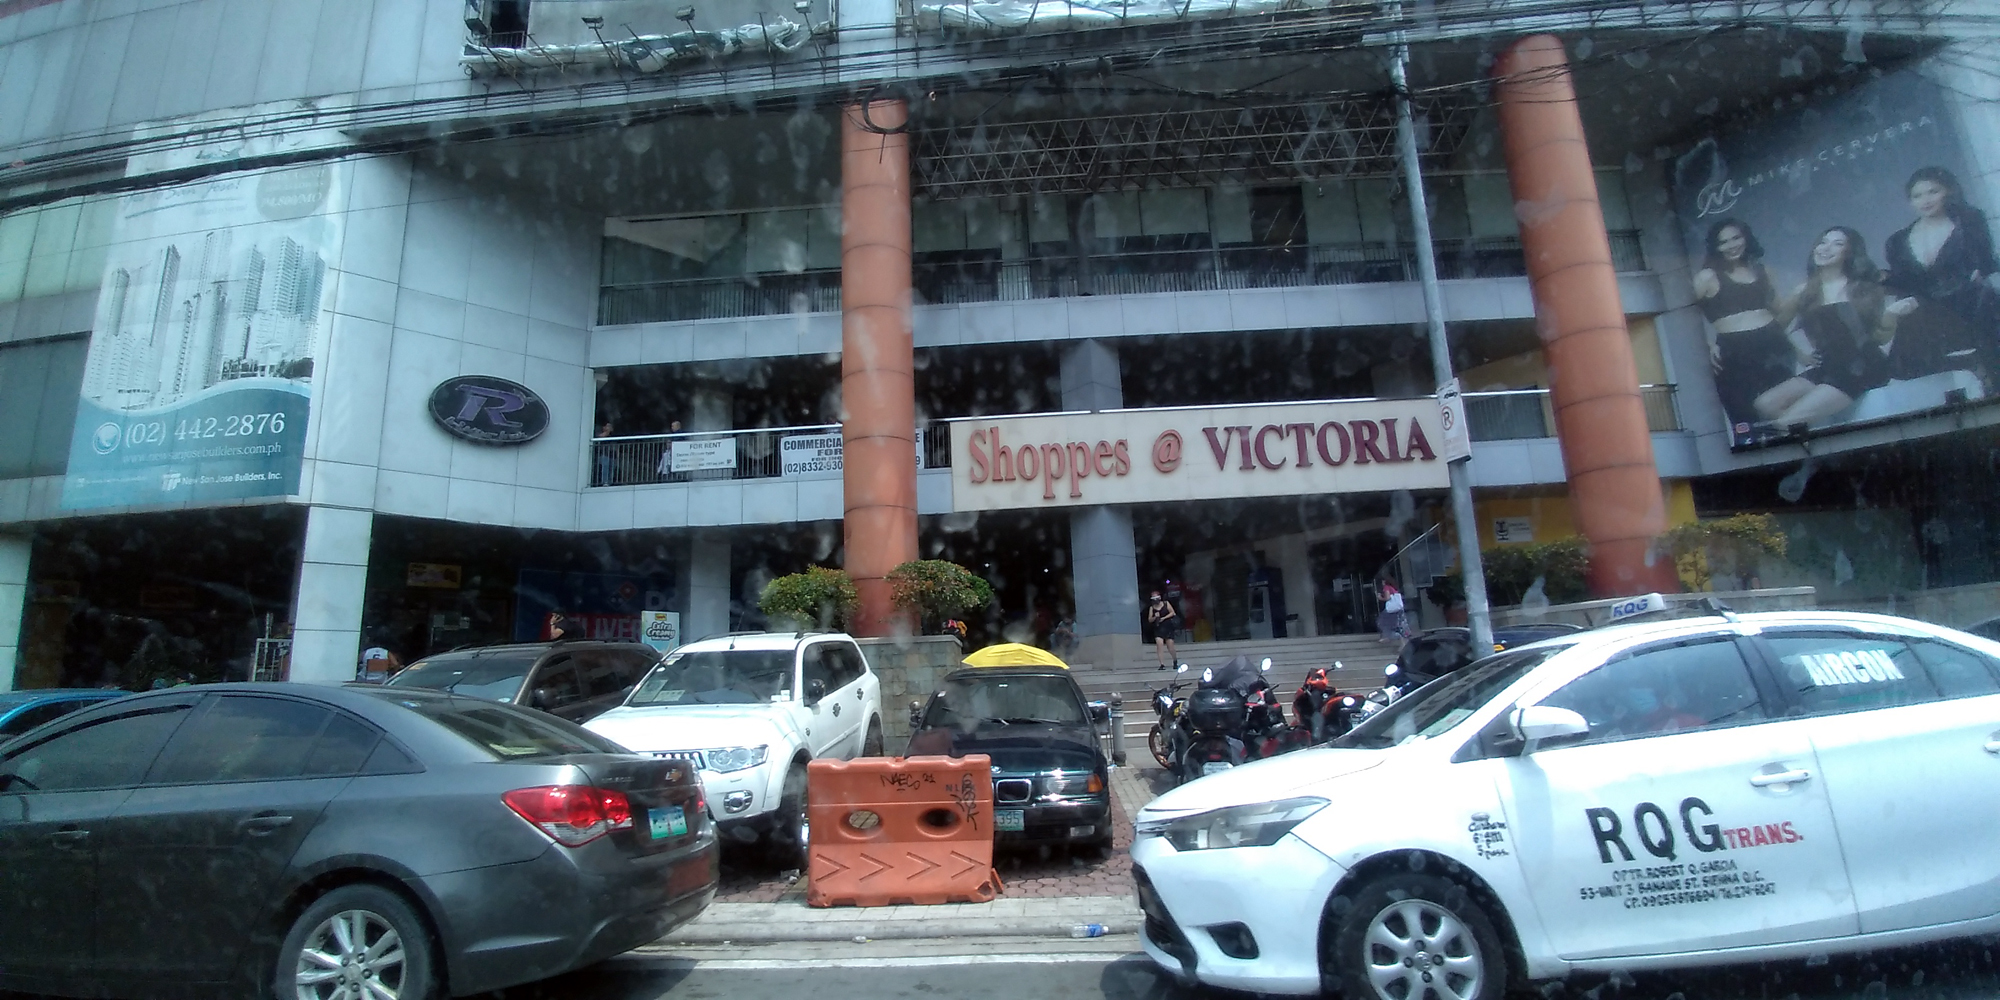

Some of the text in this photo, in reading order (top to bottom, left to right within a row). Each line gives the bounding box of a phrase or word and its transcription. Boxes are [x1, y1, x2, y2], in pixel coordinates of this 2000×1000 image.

[1749, 116, 1932, 187] MIKE CERVERA
[125, 412, 285, 448] (02) 442-2876
[783, 438, 843, 451] COMMERCIA
[817, 449, 843, 457] FOR
[968, 416, 1438, 499] Shoppes @ VICTORIA
[784, 461, 843, 476] (02)8332-930
[200, 475, 216, 484] San
[217, 474, 233, 483] Jose
[234, 472, 266, 482] Builders,
[268, 472, 283, 481] Inc.
[1613, 598, 1649, 618] RQG
[646, 628, 675, 638] Creamy
[652, 621, 672, 630] Extra
[1801, 649, 1905, 686] AIRCON
[1585, 796, 1804, 864] RQG TRANS.
[1684, 877, 1700, 890] ST.
